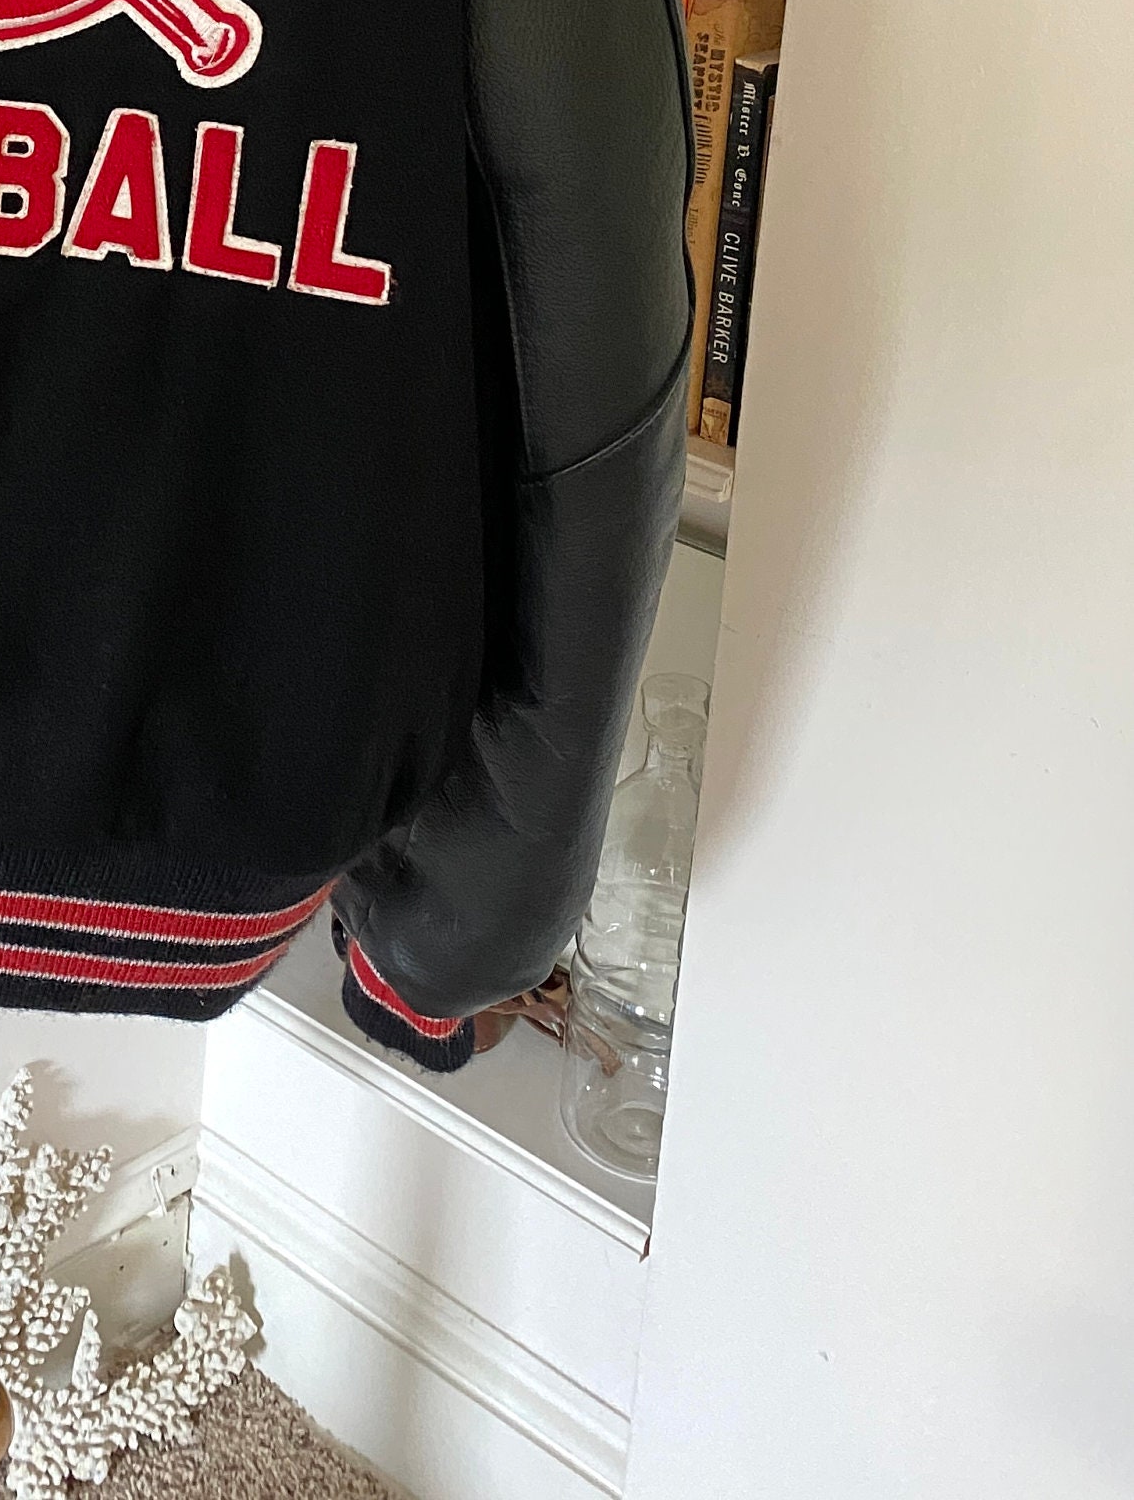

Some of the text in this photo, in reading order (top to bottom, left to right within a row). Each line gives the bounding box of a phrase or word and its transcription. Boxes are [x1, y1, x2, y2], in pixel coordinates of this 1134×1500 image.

[693, 32, 710, 112] SEAPORT
[705, 48, 726, 113] MYSTIC
[712, 232, 741, 364] CLIVE BARKER
